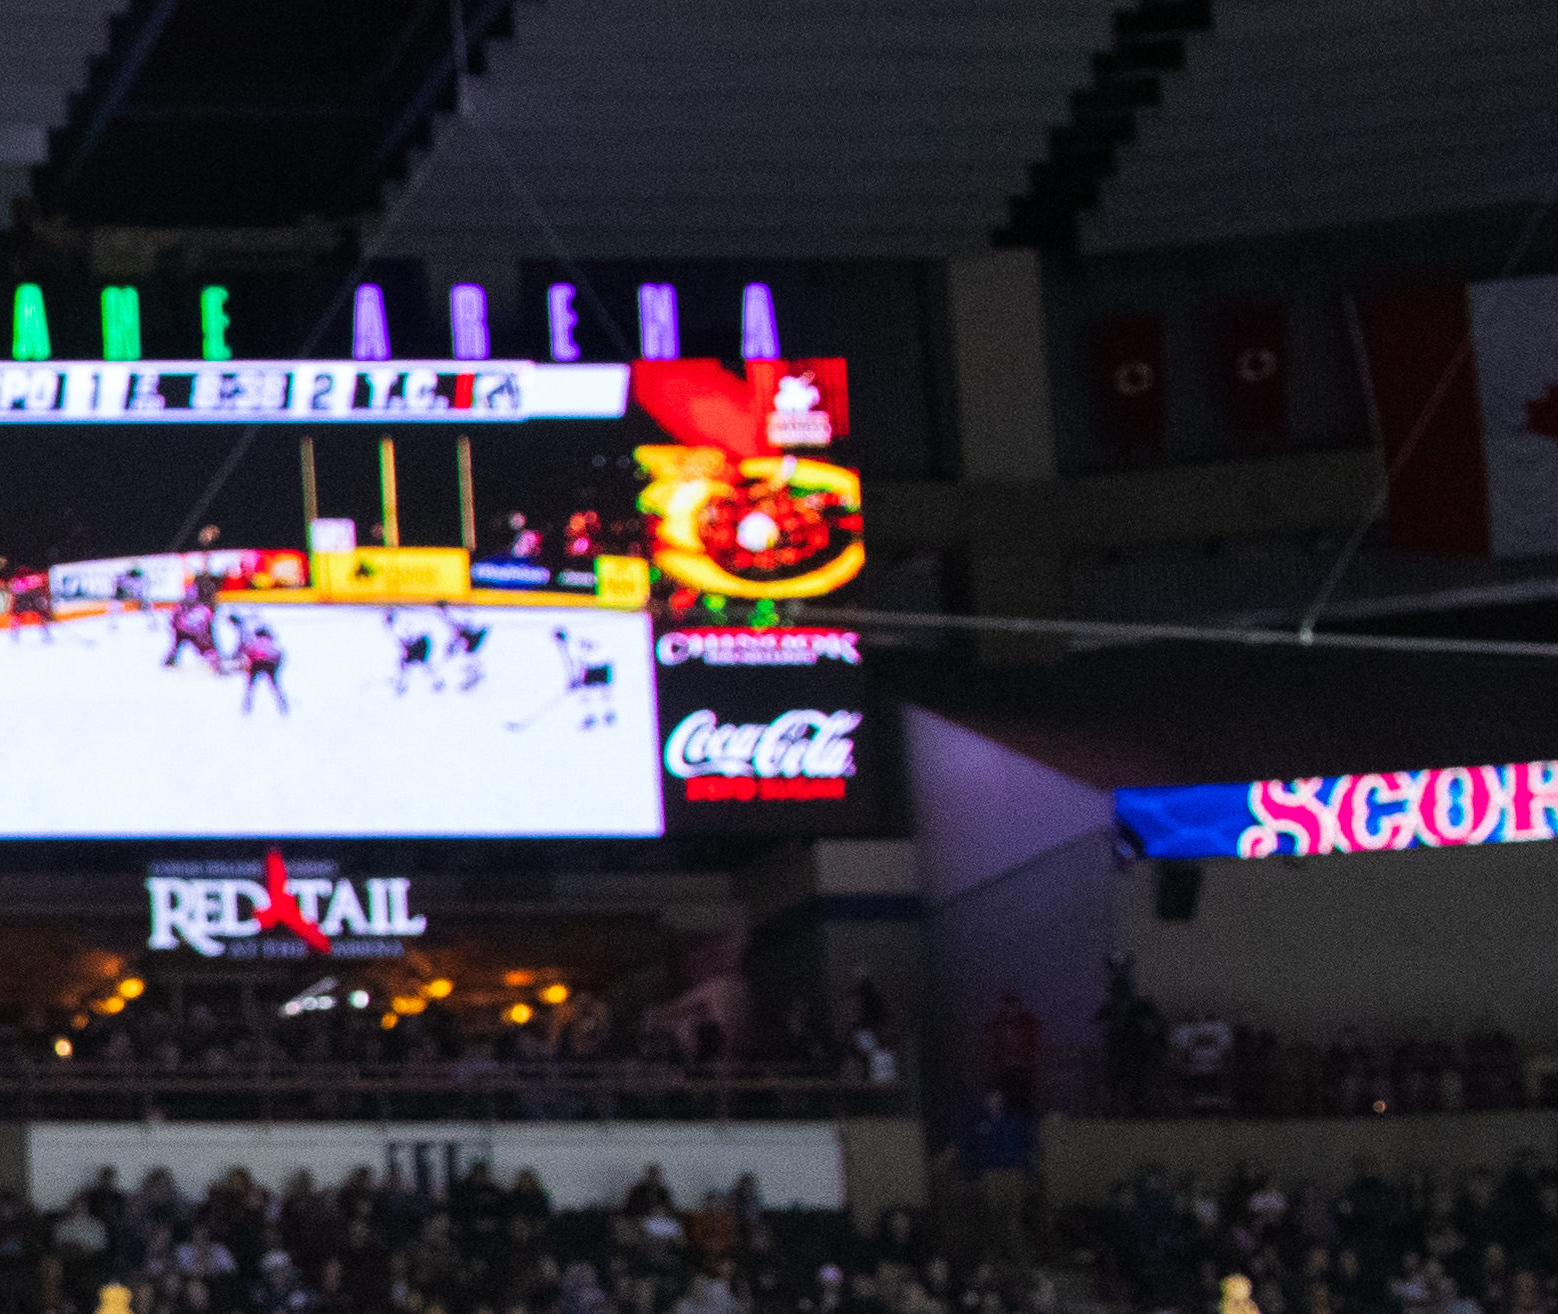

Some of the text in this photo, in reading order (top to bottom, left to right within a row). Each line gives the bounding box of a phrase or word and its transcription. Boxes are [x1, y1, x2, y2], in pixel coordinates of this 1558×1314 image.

[353, 283, 780, 361] ARENA
[144, 876, 427, 957] RED TAIL
